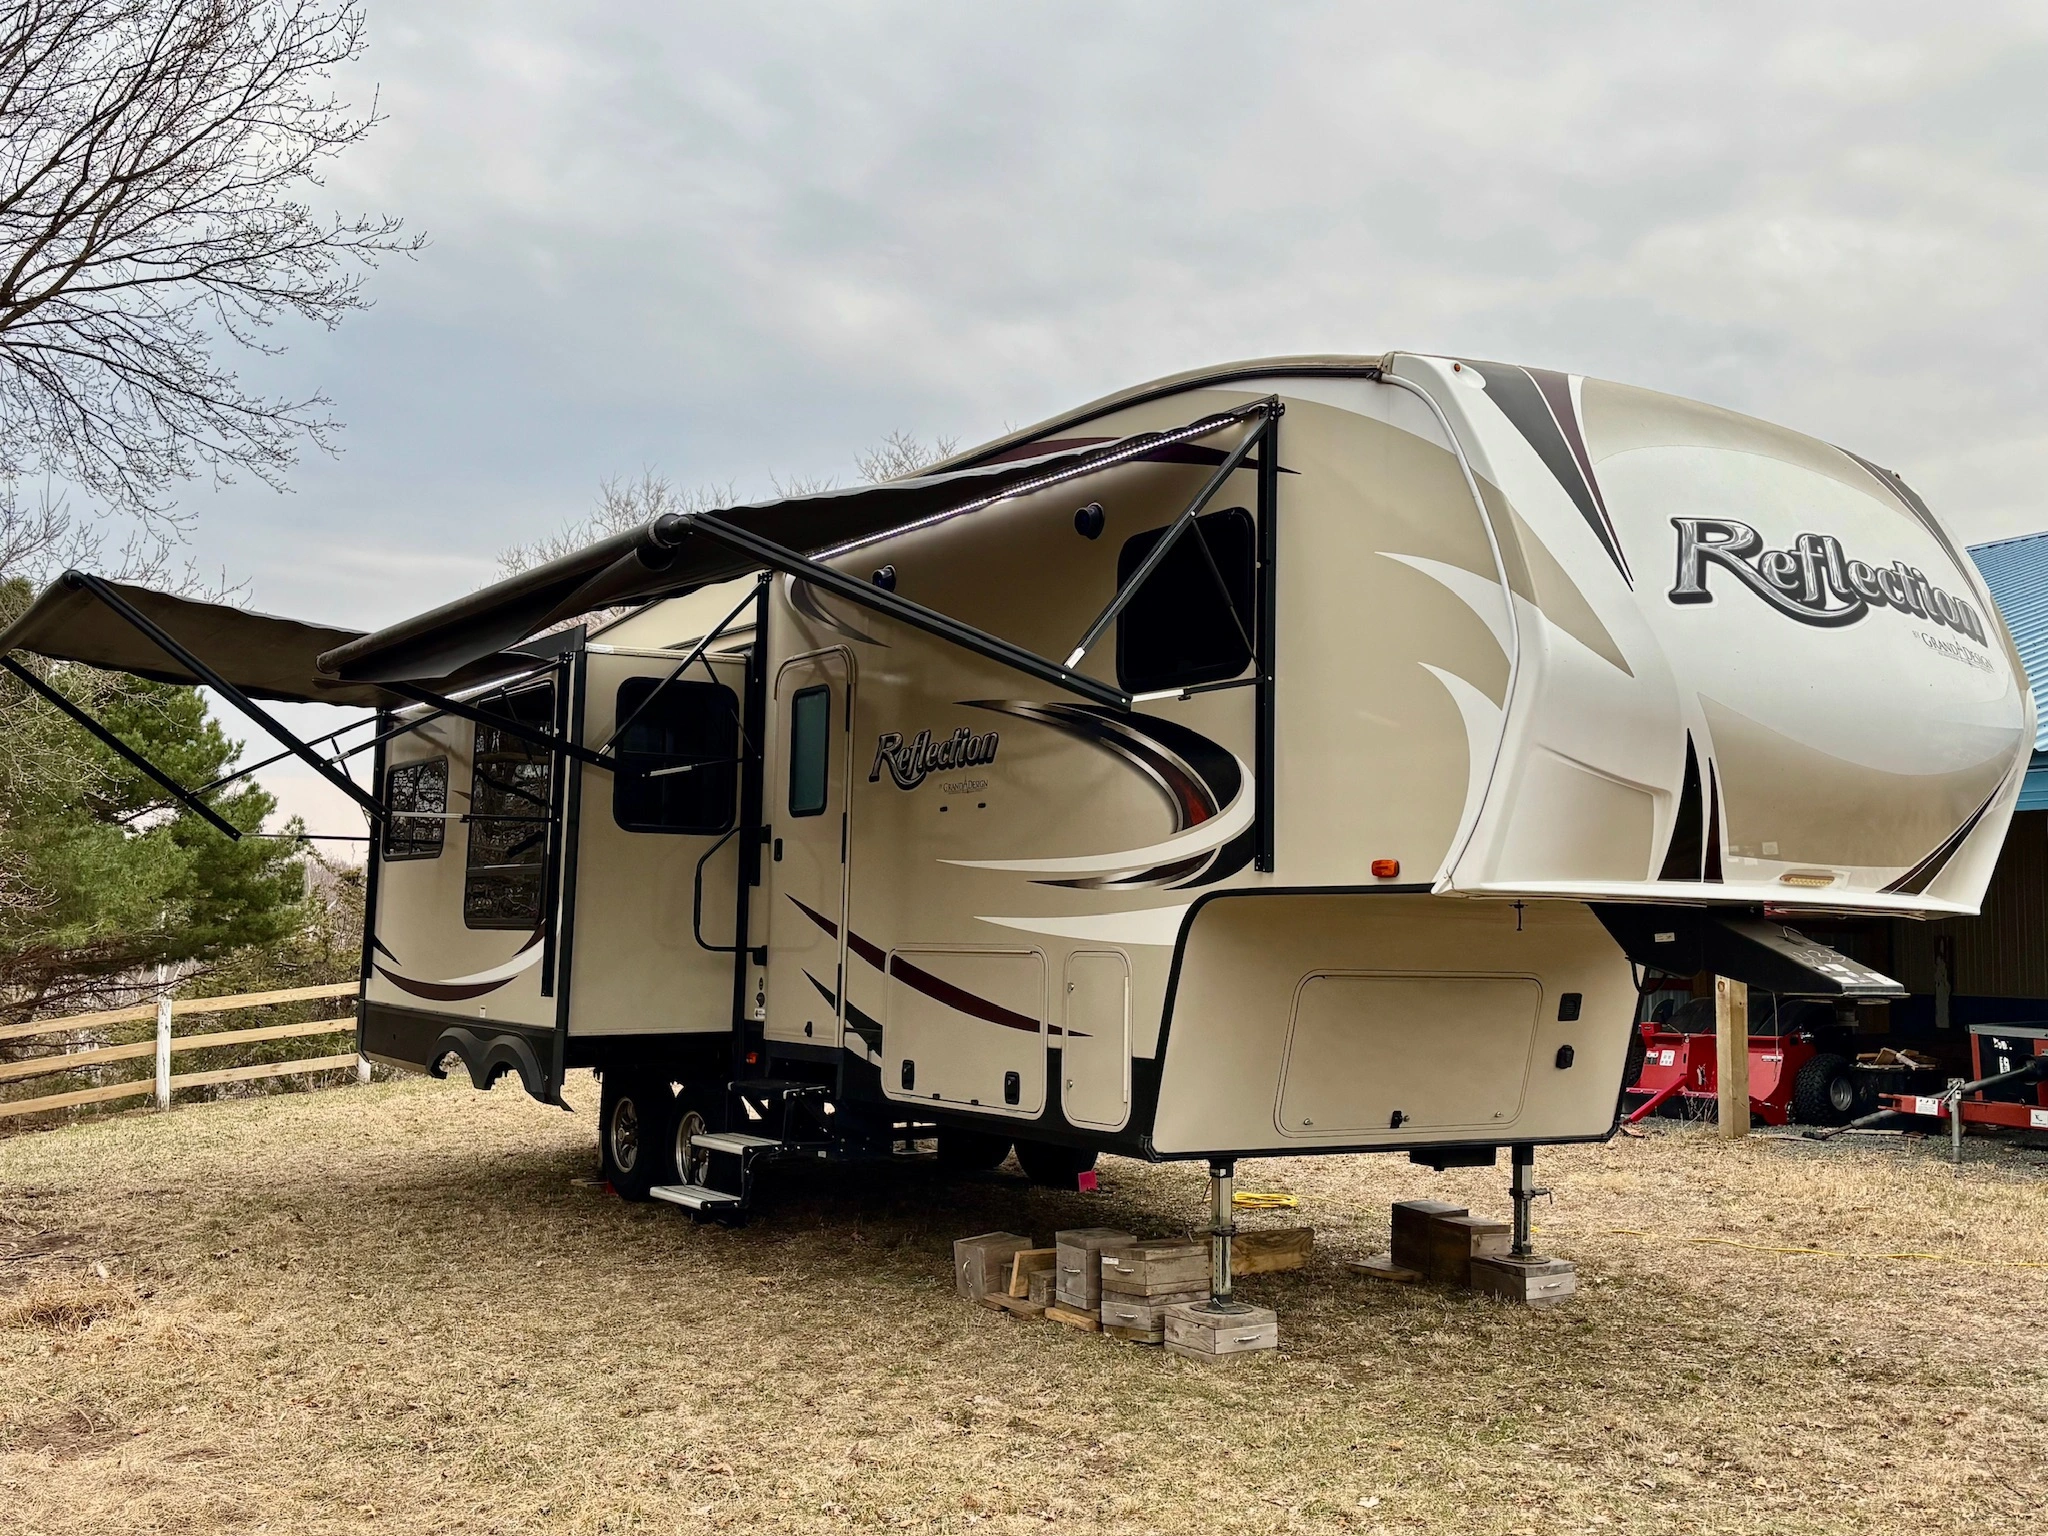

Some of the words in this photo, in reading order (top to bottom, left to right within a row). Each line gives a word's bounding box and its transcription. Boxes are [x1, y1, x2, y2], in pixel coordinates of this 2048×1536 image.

[1668, 516, 1988, 648] Reflection
[1921, 632, 1959, 656] GRAND
[1961, 646, 1995, 671] DESIGN
[868, 727, 999, 791] Reflection
